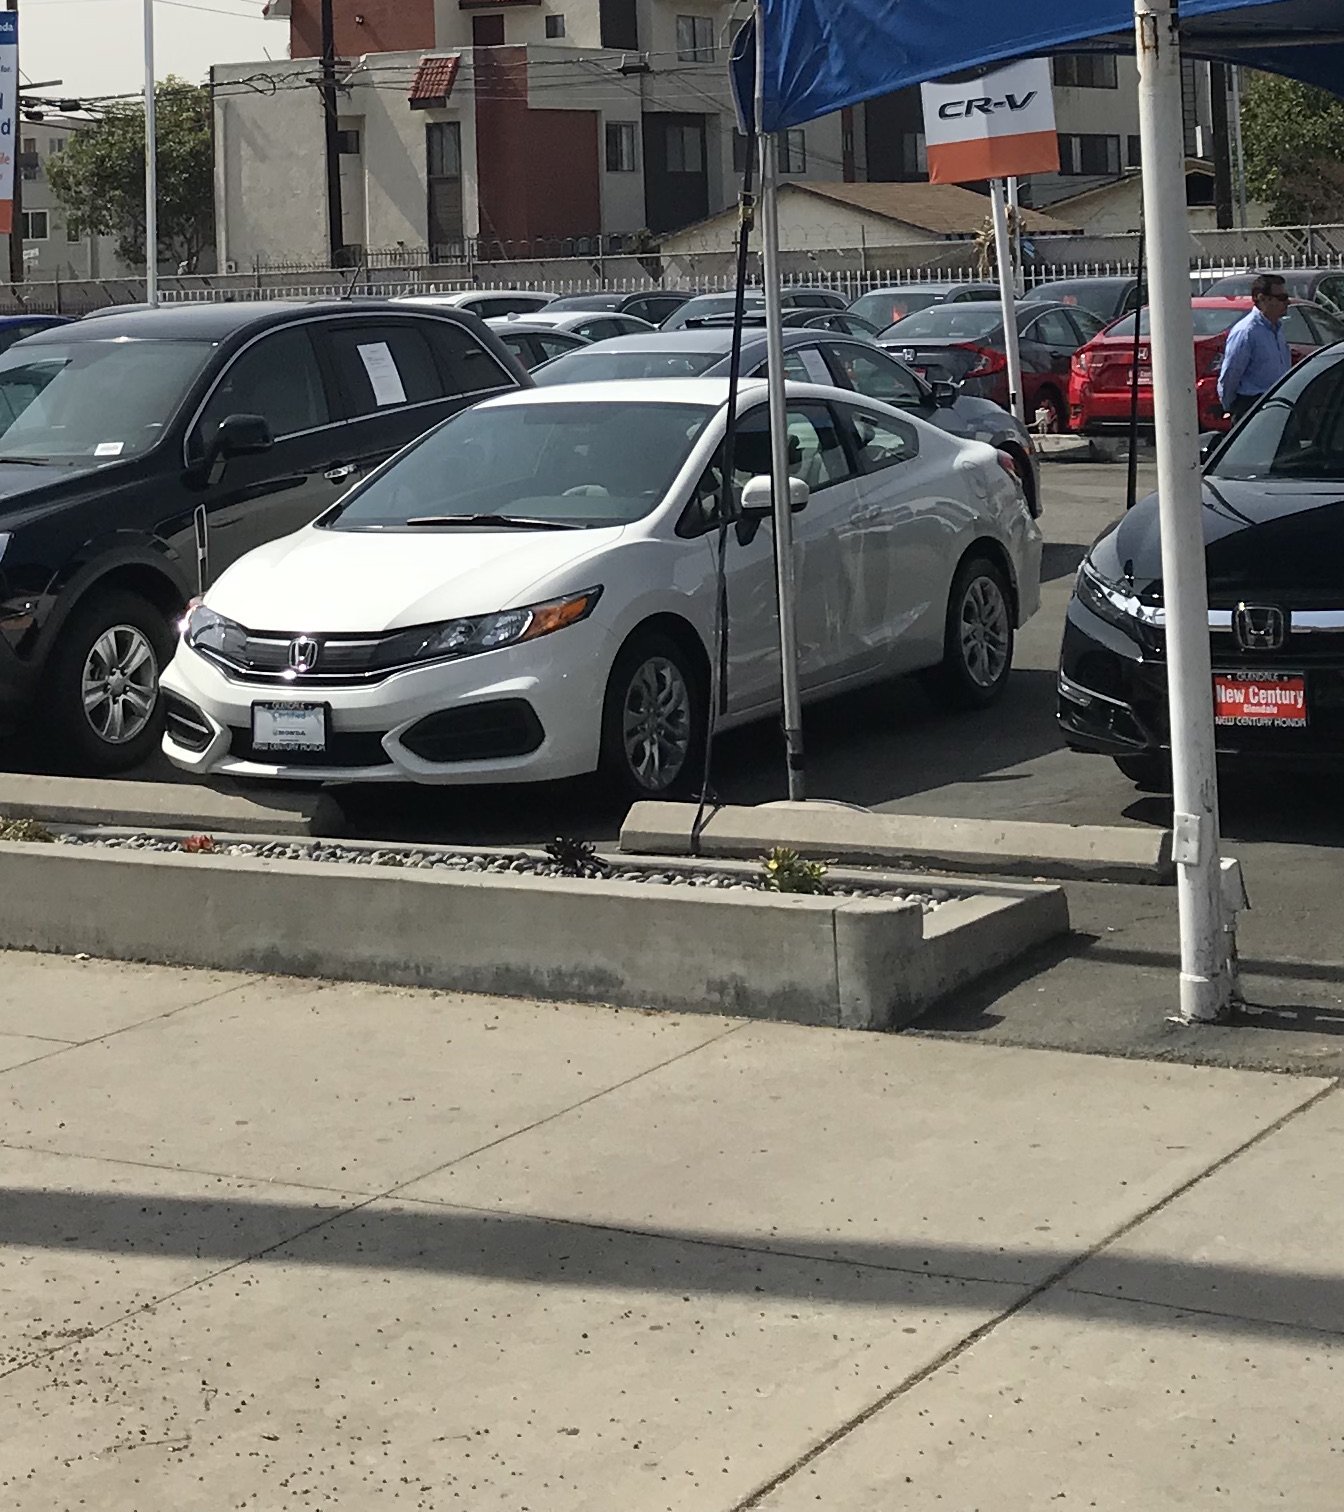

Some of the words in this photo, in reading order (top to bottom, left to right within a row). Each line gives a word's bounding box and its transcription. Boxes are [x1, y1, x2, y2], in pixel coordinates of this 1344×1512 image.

[938, 91, 1038, 120] CR-V
[1216, 685, 1245, 703] New
[1249, 685, 1303, 709] Century
[1215, 716, 1234, 726] NEW
[1236, 716, 1272, 726] CENTURY
